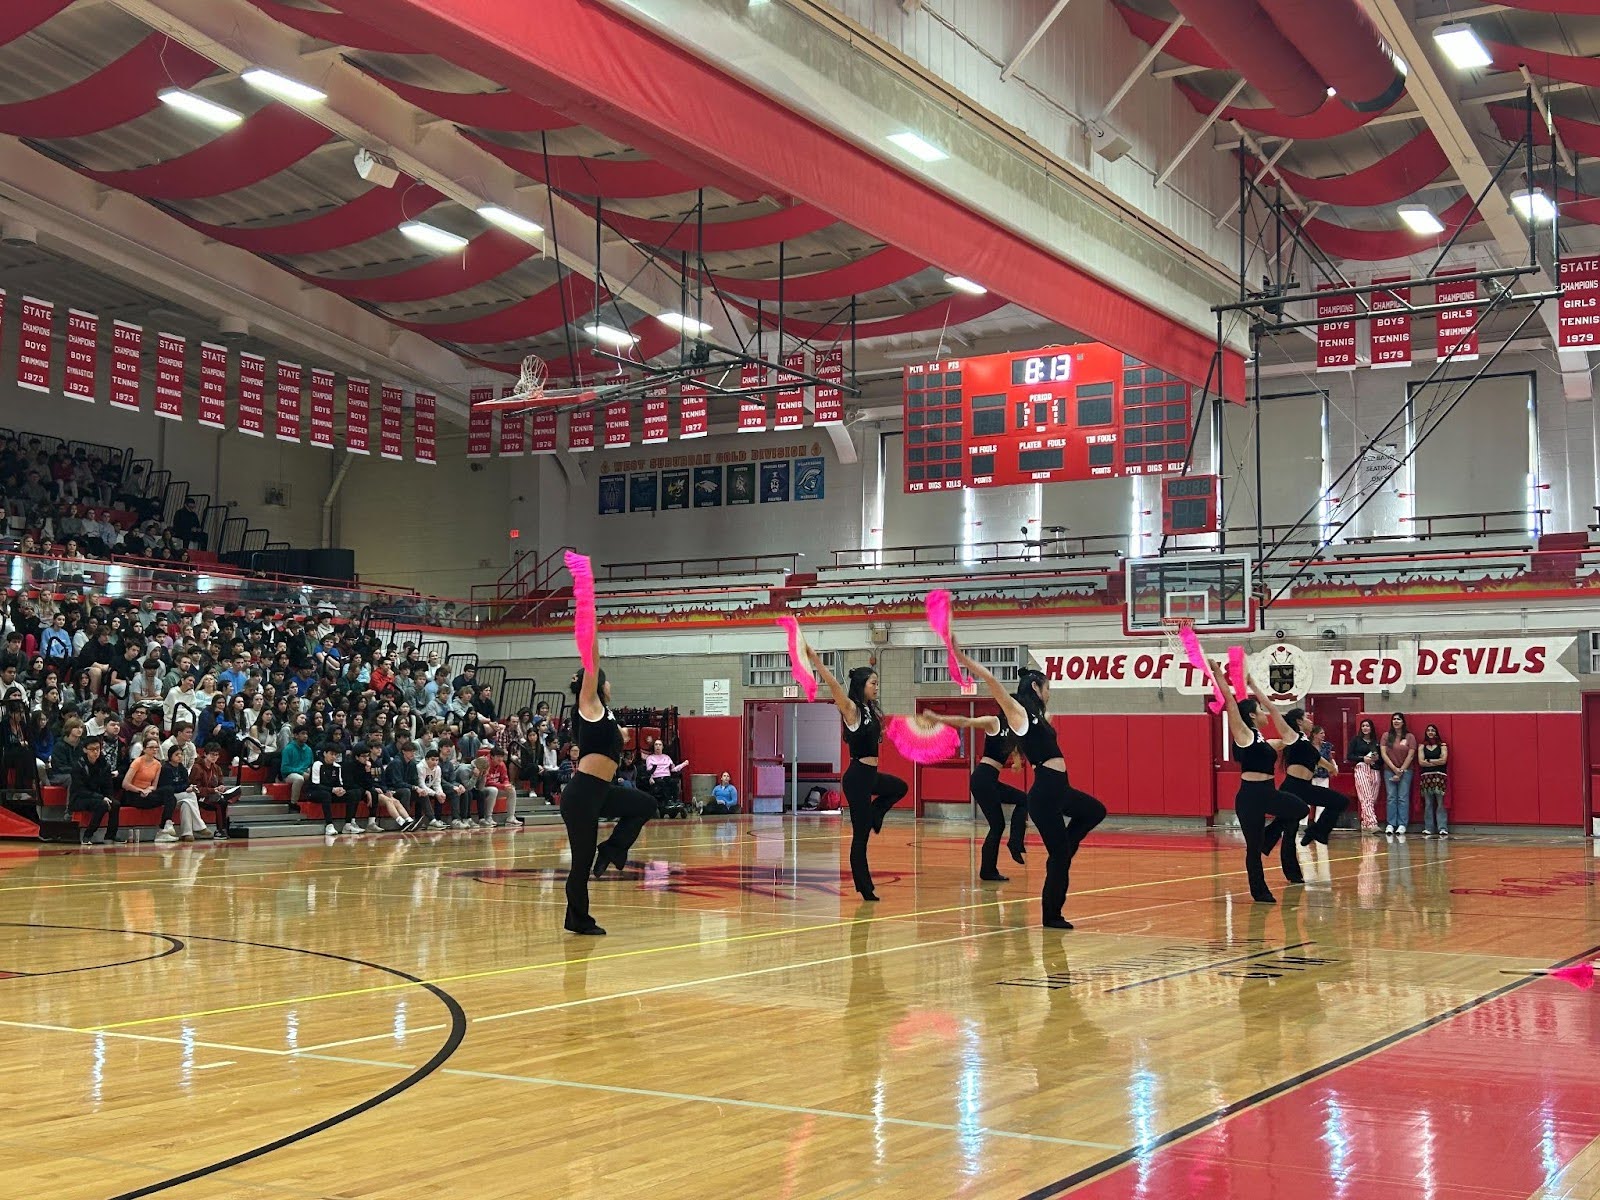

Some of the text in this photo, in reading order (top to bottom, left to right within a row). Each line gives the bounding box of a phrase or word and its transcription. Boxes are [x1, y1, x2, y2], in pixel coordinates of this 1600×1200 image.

[1560, 260, 1598, 273] STATE
[1560, 280, 1598, 292] CHAMPIONS
[1438, 290, 1474, 303] CHAMPIONS
[1564, 298, 1596, 308] GIRLS
[24, 305, 52, 320] STATE
[1320, 304, 1354, 314] CHAMPIONS
[1442, 310, 1472, 320] GIRLS
[69, 318, 96, 332] STATE
[1378, 317, 1404, 327] BOYS
[1560, 315, 1600, 326] TENNIS
[23, 322, 50, 336] CHAMPIONS
[1324, 322, 1350, 331] BOYS
[114, 328, 140, 342] STATE
[1373, 334, 1410, 344] TENNIS
[1566, 334, 1594, 343] 1979
[25, 340, 46, 352] BOYS
[68, 334, 96, 348] CHAMPIONS
[1319, 338, 1354, 348] TENNIS
[160, 340, 184, 353] STATE
[70, 352, 91, 362] BOYS
[114, 346, 140, 358] CHAMPIONS
[202, 350, 226, 363] STATE
[1378, 350, 1404, 360] 1979
[21, 356, 48, 368] SWIMMING
[158, 356, 182, 368] CHAMPIONS
[1324, 354, 1348, 364] 1978
[116, 362, 136, 372] BOYS
[242, 360, 264, 372] STATE
[910, 361, 960, 374] PLYR FLS PTS
[1025, 354, 1071, 385] 8:13
[24, 372, 44, 382] 1973
[160, 372, 180, 382] BOYS
[202, 366, 226, 378] CHAMPIONS
[278, 368, 300, 380] STATE
[112, 376, 138, 388] TENNIS
[240, 376, 264, 387] CHAMPIONS
[312, 376, 333, 387] STATE
[70, 382, 89, 392] 1973
[204, 382, 222, 392] BOYS
[348, 384, 368, 394] STATE
[115, 392, 134, 402] 1973
[243, 390, 260, 400] BOYS
[382, 390, 402, 400] STATE
[471, 392, 493, 400] STATE
[200, 396, 224, 408] TENNIS
[280, 398, 296, 408] BOYS
[416, 396, 434, 406] STATE
[647, 402, 664, 410] BOYS
[776, 400, 802, 410] TENNIS
[160, 402, 178, 412] 1974
[314, 406, 330, 414] BOYS
[608, 408, 626, 416] BOYS
[204, 411, 220, 420] 1974
[278, 412, 300, 422] TENNIS
[350, 412, 366, 421] BOYS
[573, 412, 590, 420] BOYS
[682, 410, 706, 418] TENNIS
[820, 412, 838, 420] 1978
[242, 420, 259, 428] 1975
[606, 420, 630, 428] TENNIS
[744, 418, 762, 426] 1978
[280, 426, 296, 434] 1975
[570, 424, 594, 434] TENNIS
[686, 424, 702, 432] 1977
[314, 432, 330, 441] 1975
[1086, 434, 1116, 444] TM FOULS
[573, 438, 590, 446] 1976
[1019, 438, 1066, 450] PLAYER FOULS
[979, 444, 998, 454] FOULS
[614, 444, 807, 472] WEST SUBURBAN GOLD DIVISION
[1092, 466, 1112, 474] POINTS
[1126, 462, 1184, 474] PLYR DIGS KILLS
[910, 480, 962, 490] PLYR DIGS KILLS
[1045, 654, 1128, 680] HOME
[1134, 654, 1174, 680] OF
[1330, 658, 1402, 686] RED
[1417, 646, 1546, 676] DEVILS
